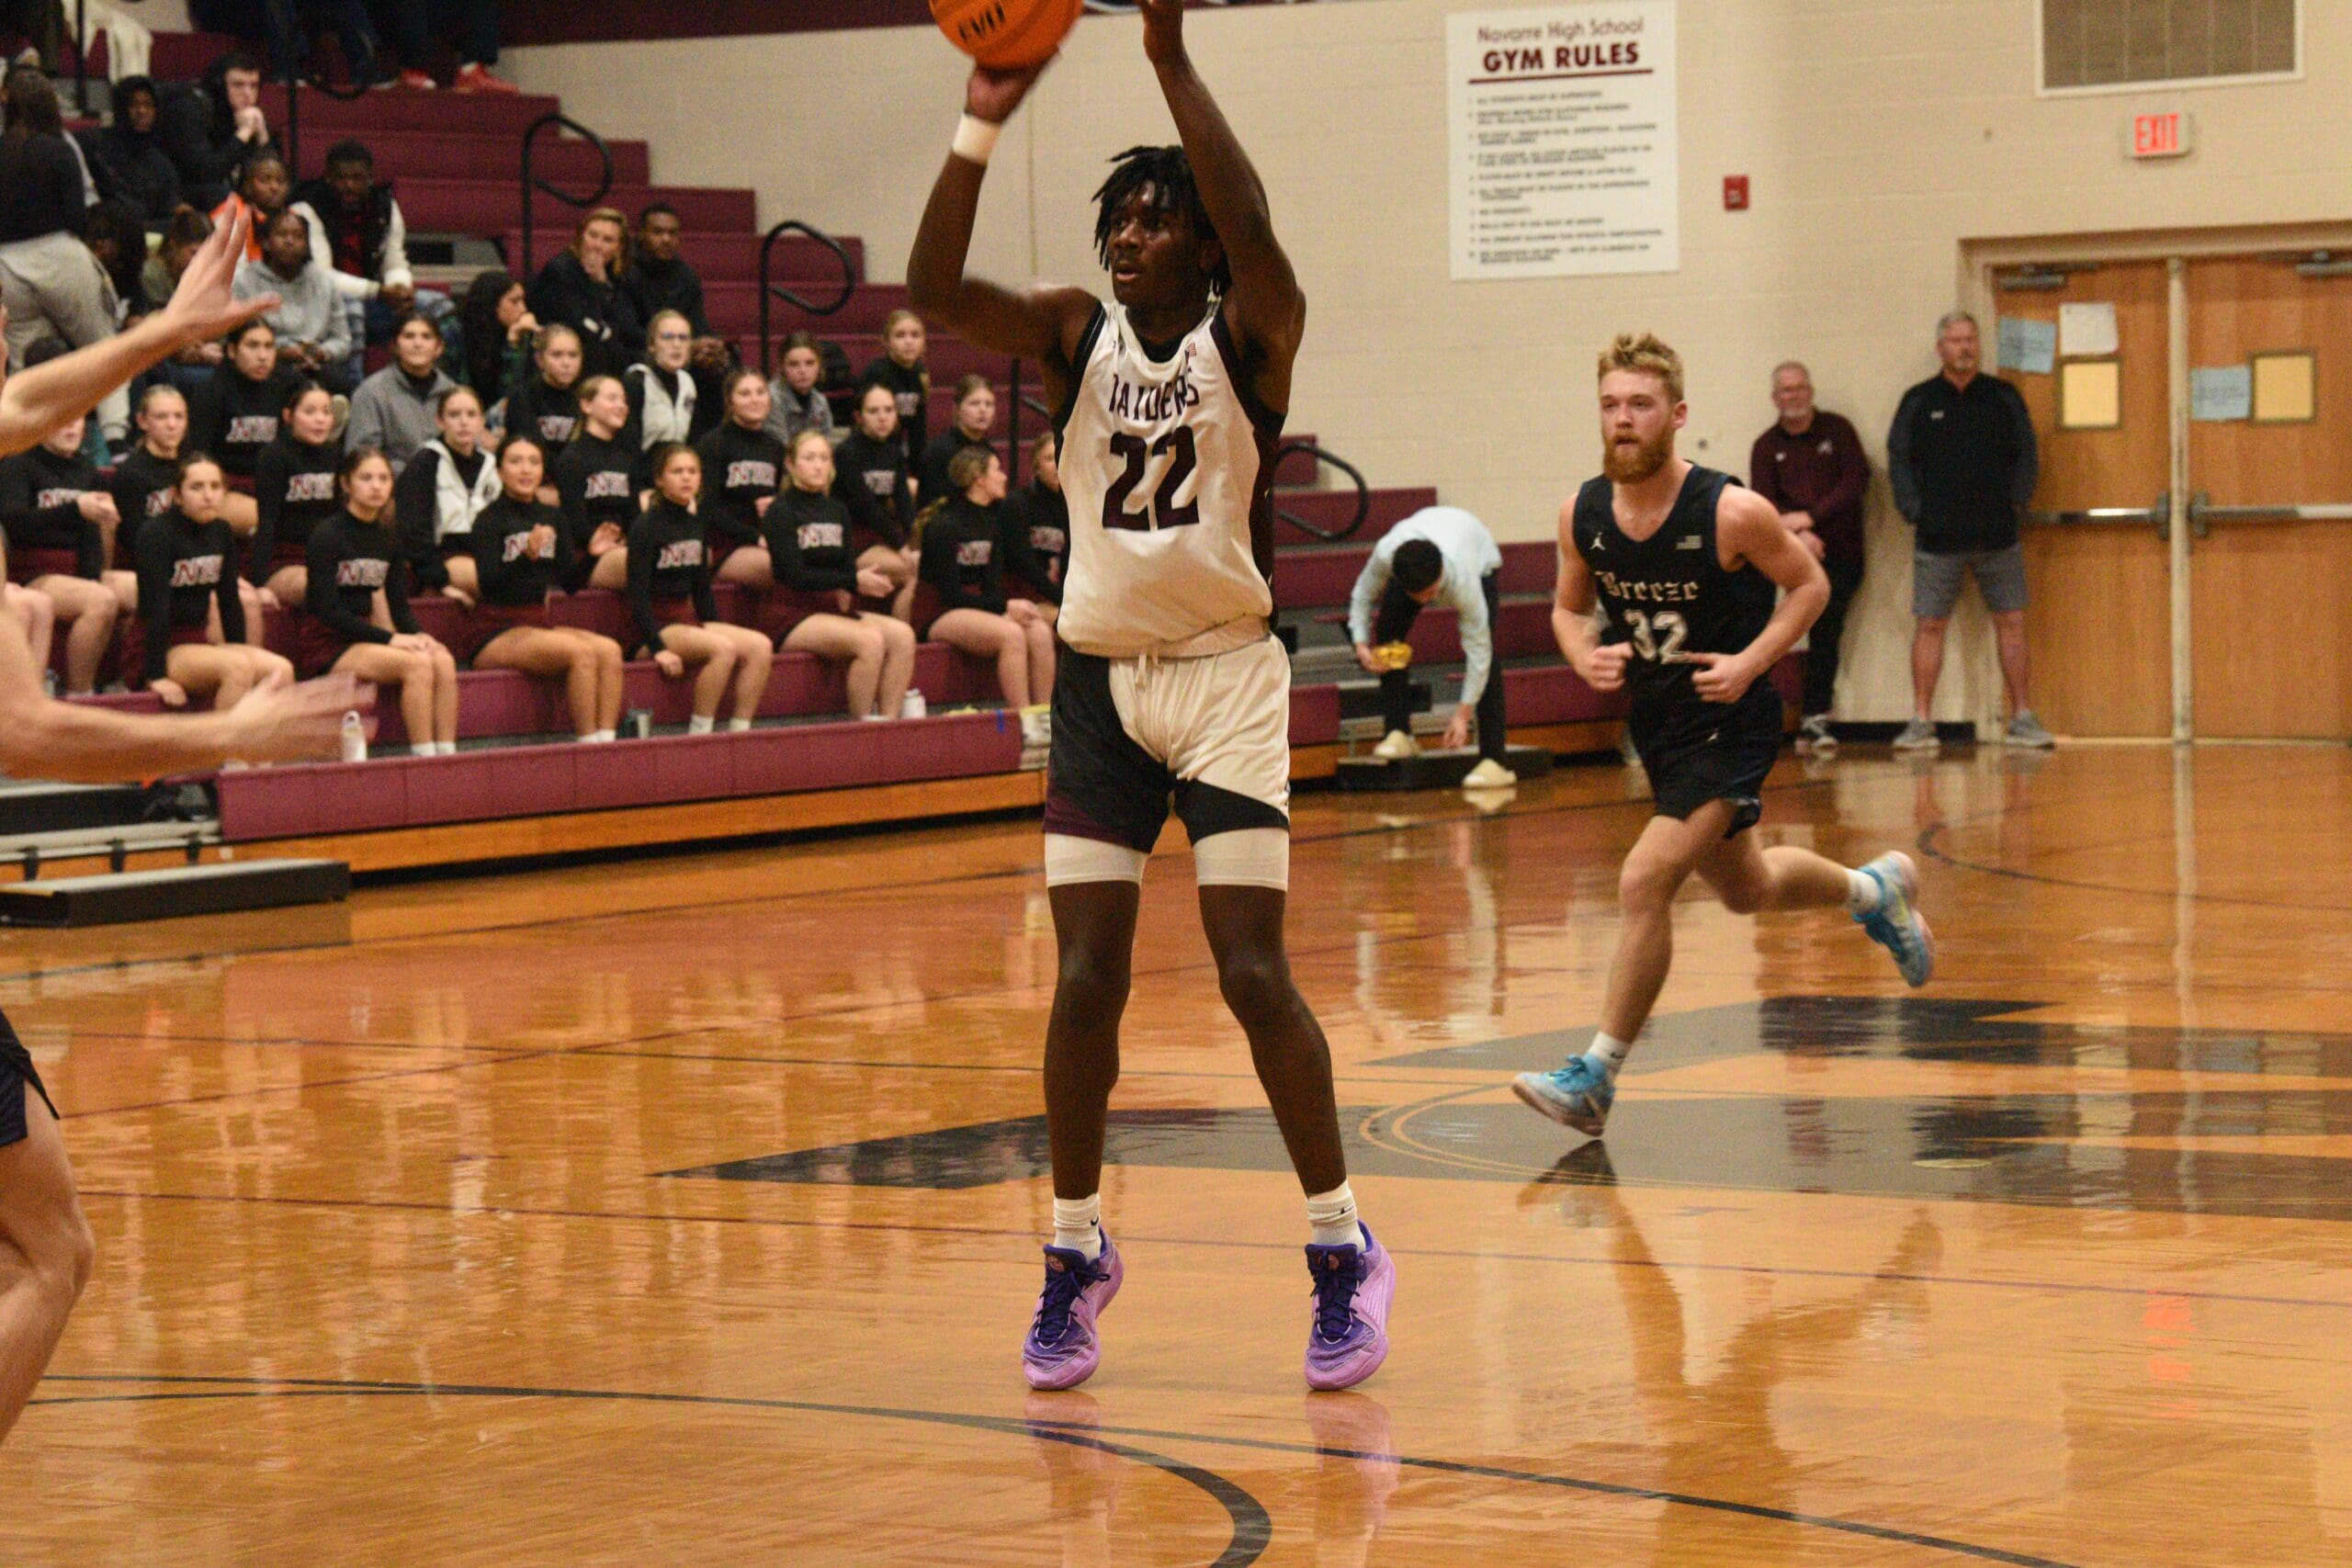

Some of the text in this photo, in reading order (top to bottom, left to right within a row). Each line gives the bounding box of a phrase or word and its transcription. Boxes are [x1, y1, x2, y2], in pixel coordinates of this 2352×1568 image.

[1477, 16, 1645, 43] Navarre High School
[1483, 41, 1639, 73] GYM RULES
[2134, 113, 2178, 154] EXIT
[1102, 425, 1200, 531] 22
[1594, 570, 1699, 602] Breeze
[1623, 608, 1695, 664] 32
